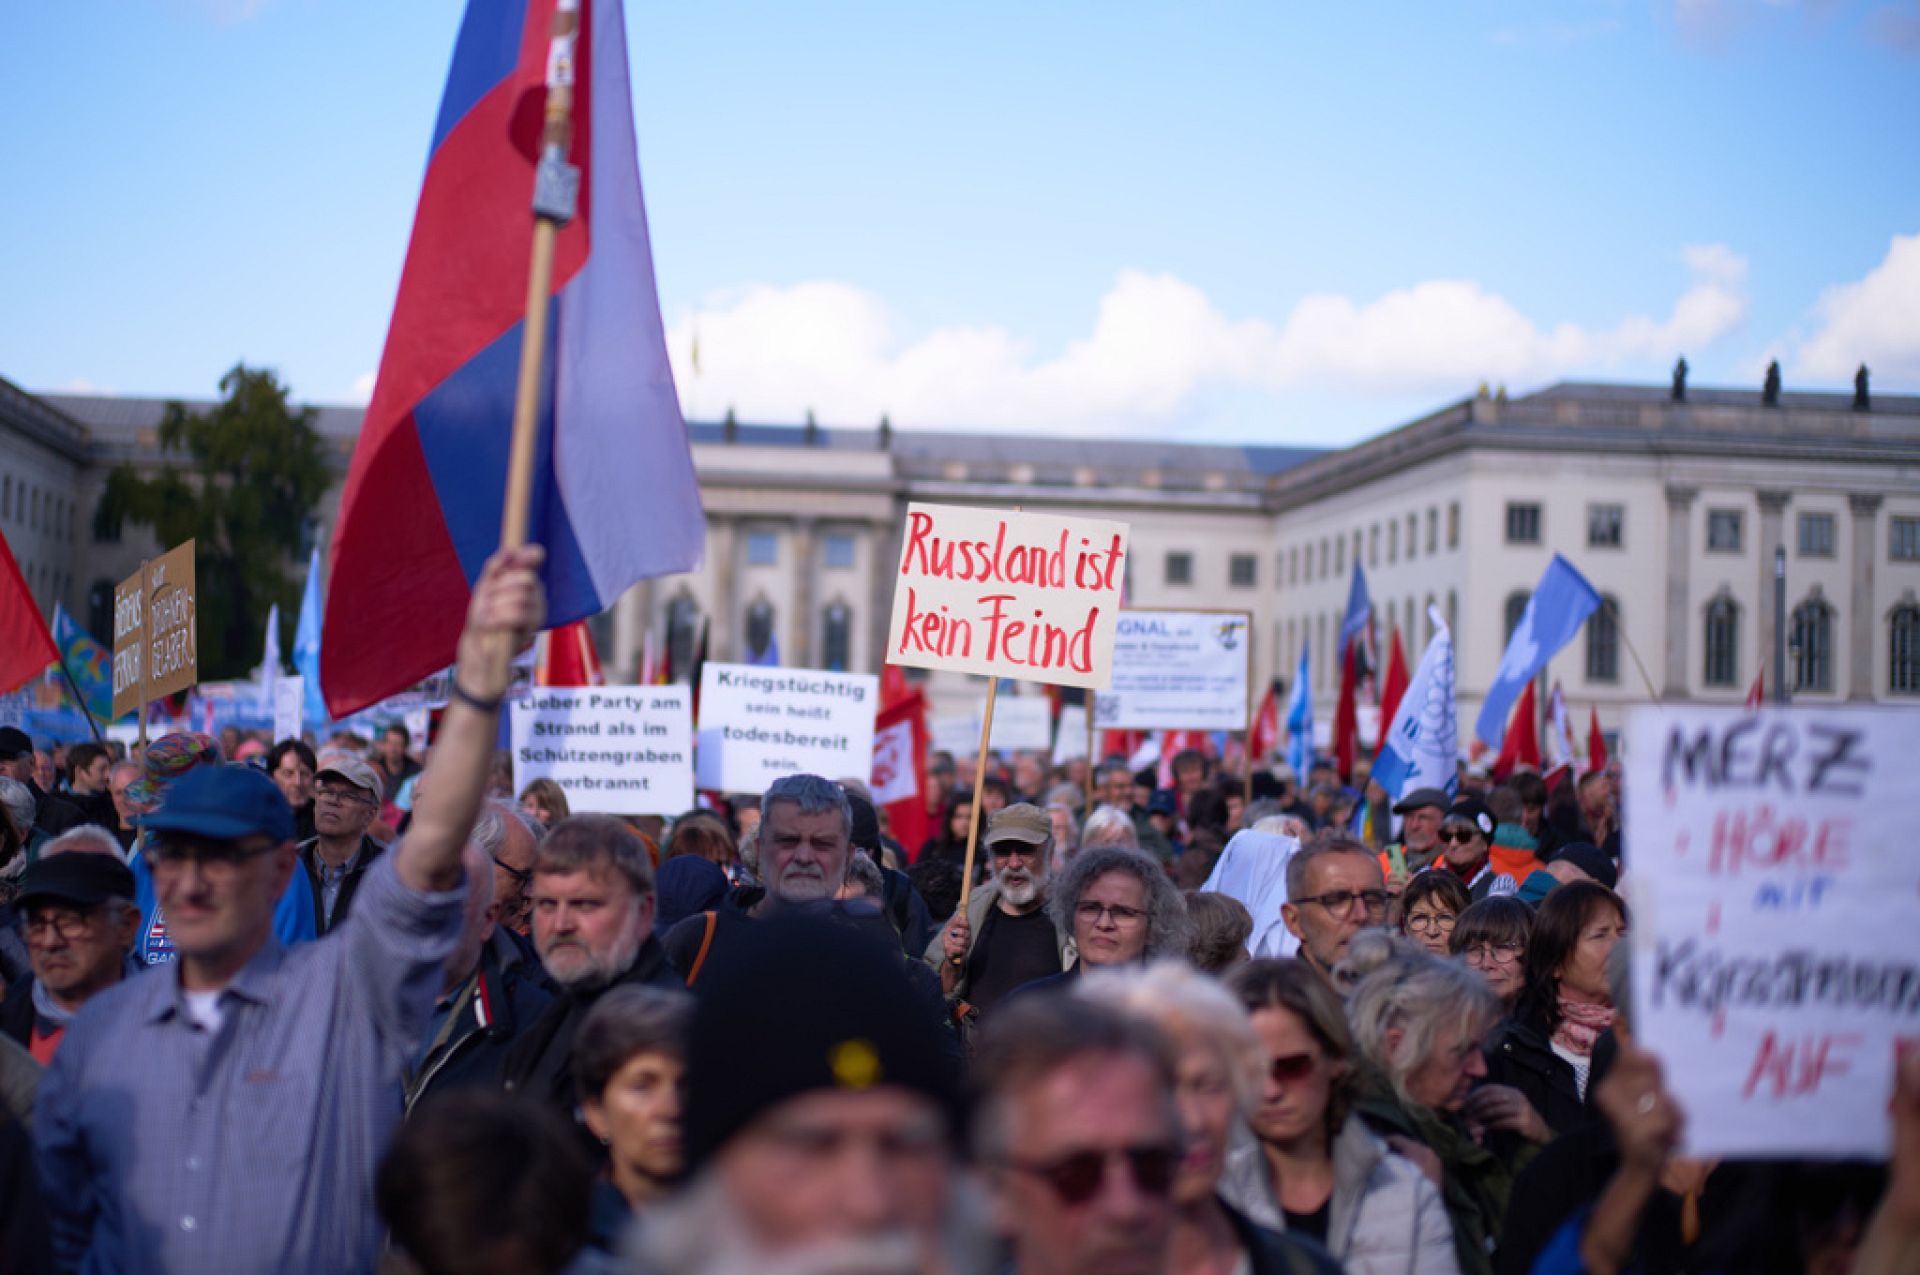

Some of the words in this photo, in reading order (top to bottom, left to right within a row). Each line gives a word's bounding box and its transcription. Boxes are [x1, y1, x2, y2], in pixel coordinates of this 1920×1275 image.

[902, 512, 1069, 588] Russland
[1075, 533, 1123, 592] ist
[900, 587, 972, 657] kein
[977, 594, 1100, 674] Feind
[519, 693, 582, 711] Lieber
[590, 694, 643, 713] Party
[651, 699, 682, 710] am
[717, 670, 866, 702] Kriegstüchtig
[745, 702, 780, 714] sein
[533, 721, 600, 736] Strand
[607, 721, 636, 736] als
[643, 721, 668, 736] im
[723, 725, 849, 751] todesbereit
[1662, 717, 1875, 798] MERZ
[1707, 803, 1853, 876] HÖRE
[1742, 1028, 1865, 1101] AUF
